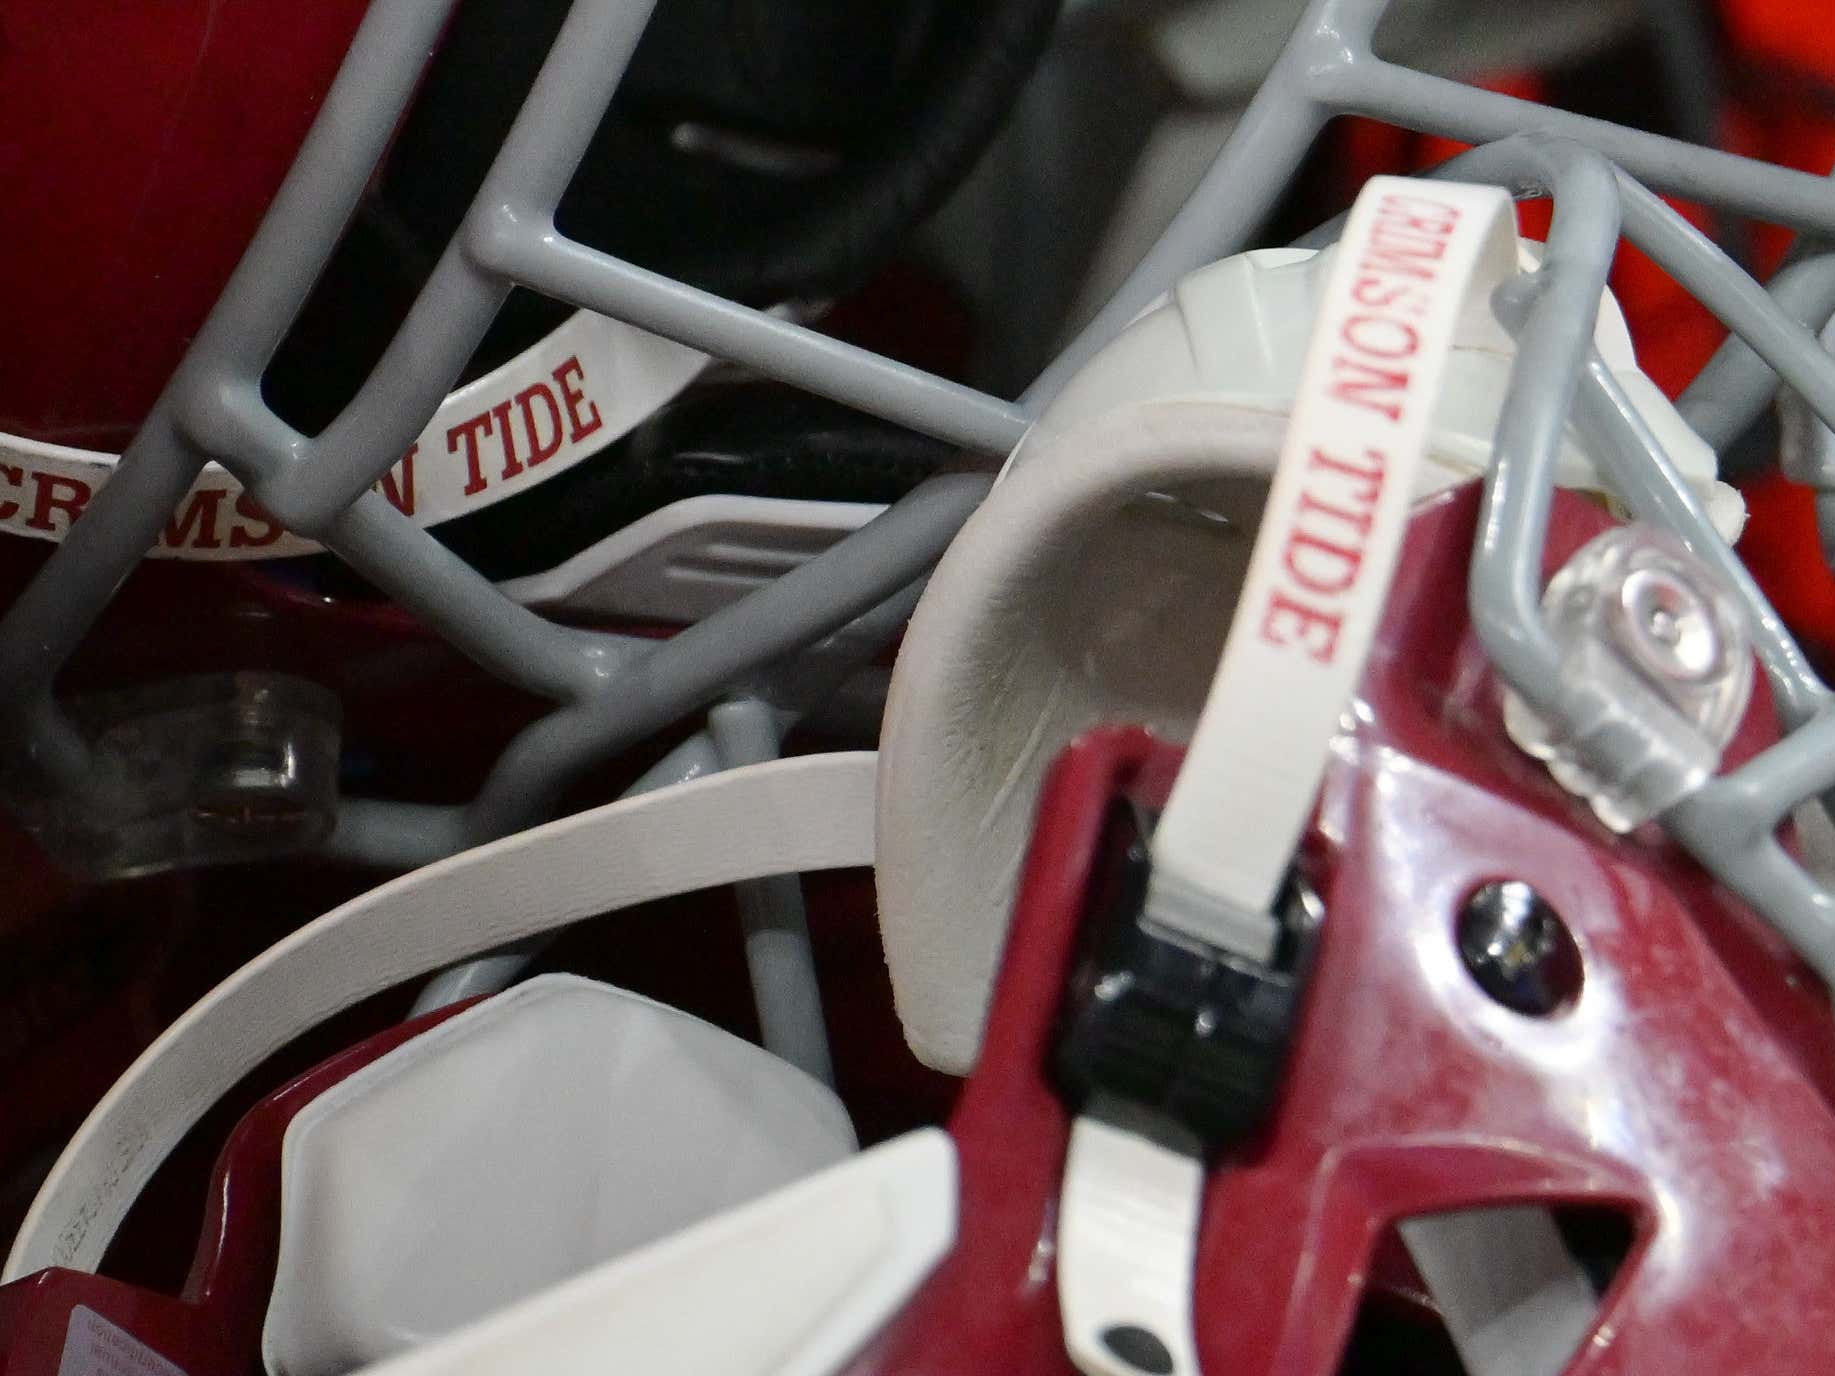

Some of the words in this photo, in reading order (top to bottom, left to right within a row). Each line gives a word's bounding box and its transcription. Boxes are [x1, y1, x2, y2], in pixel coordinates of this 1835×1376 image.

[1324, 193, 1462, 423] CRIMSON
[446, 354, 603, 496] TIDE
[1258, 448, 1389, 665] TIDE
